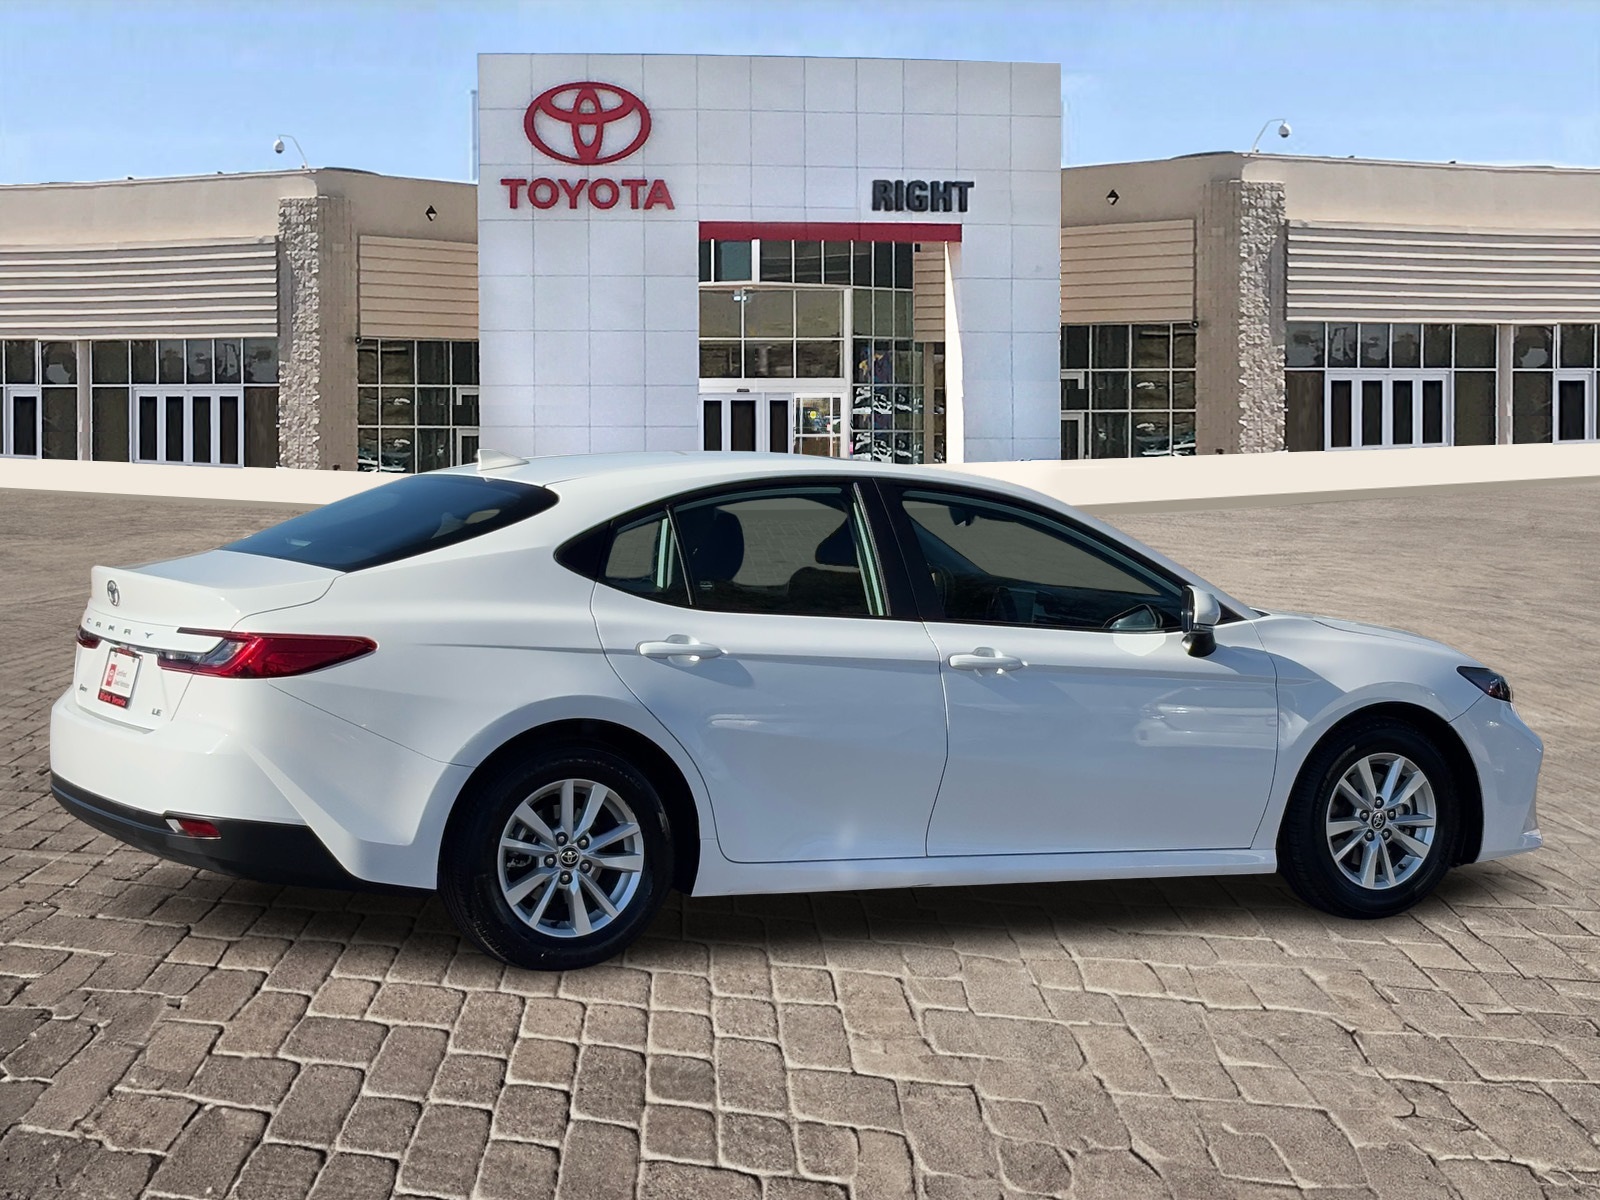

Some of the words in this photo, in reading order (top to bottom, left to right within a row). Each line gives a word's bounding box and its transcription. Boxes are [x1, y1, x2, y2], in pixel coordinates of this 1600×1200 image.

[501, 178, 675, 209] TOYOTA
[872, 180, 974, 212] RIGHT
[86, 617, 153, 639] CAMRY
[151, 708, 162, 716] LE
